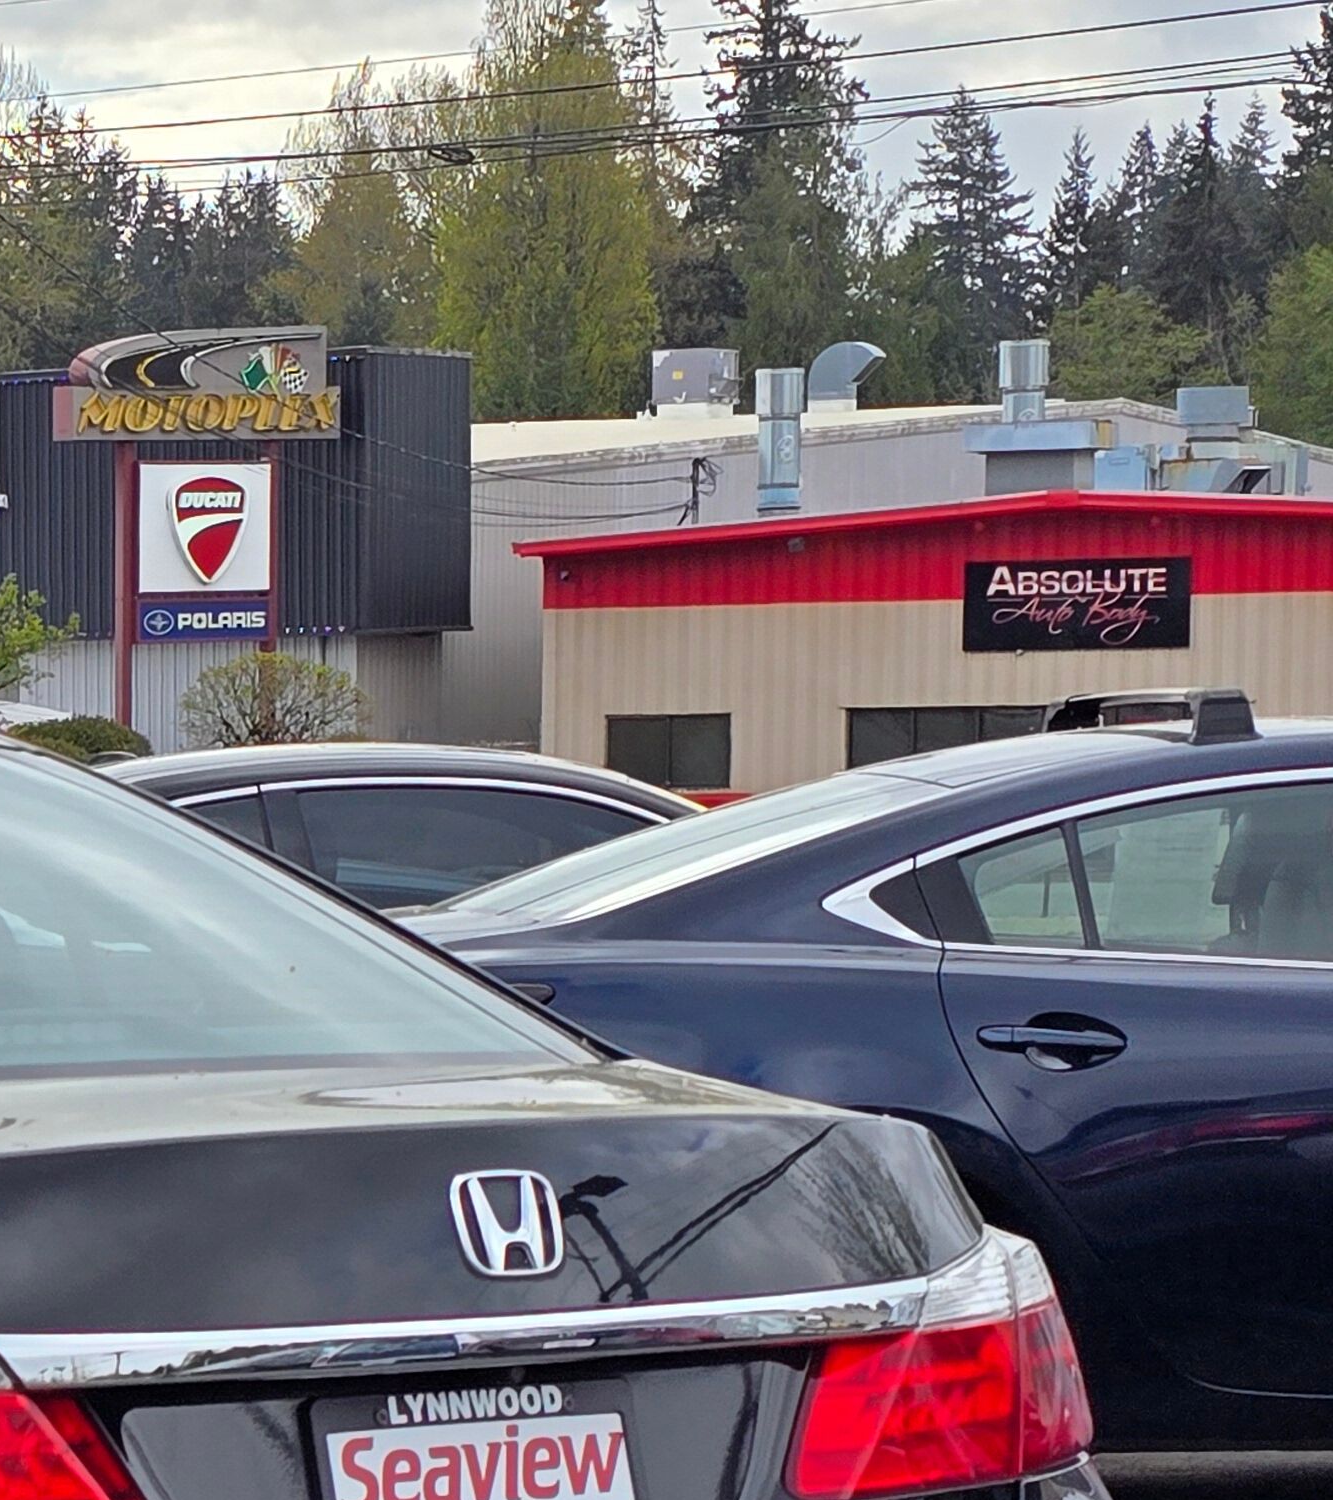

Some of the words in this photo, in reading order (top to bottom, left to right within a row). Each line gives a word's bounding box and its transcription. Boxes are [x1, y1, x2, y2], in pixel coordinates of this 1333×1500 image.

[77, 392, 339, 434] MOTOPLEX
[178, 492, 242, 509] DUCATI
[986, 566, 1168, 597] ABSOLUTE
[177, 611, 267, 631] POLARIS
[992, 597, 1076, 634] Auto
[1079, 589, 1155, 645] Body
[386, 1384, 563, 1425] LYNNWOOD
